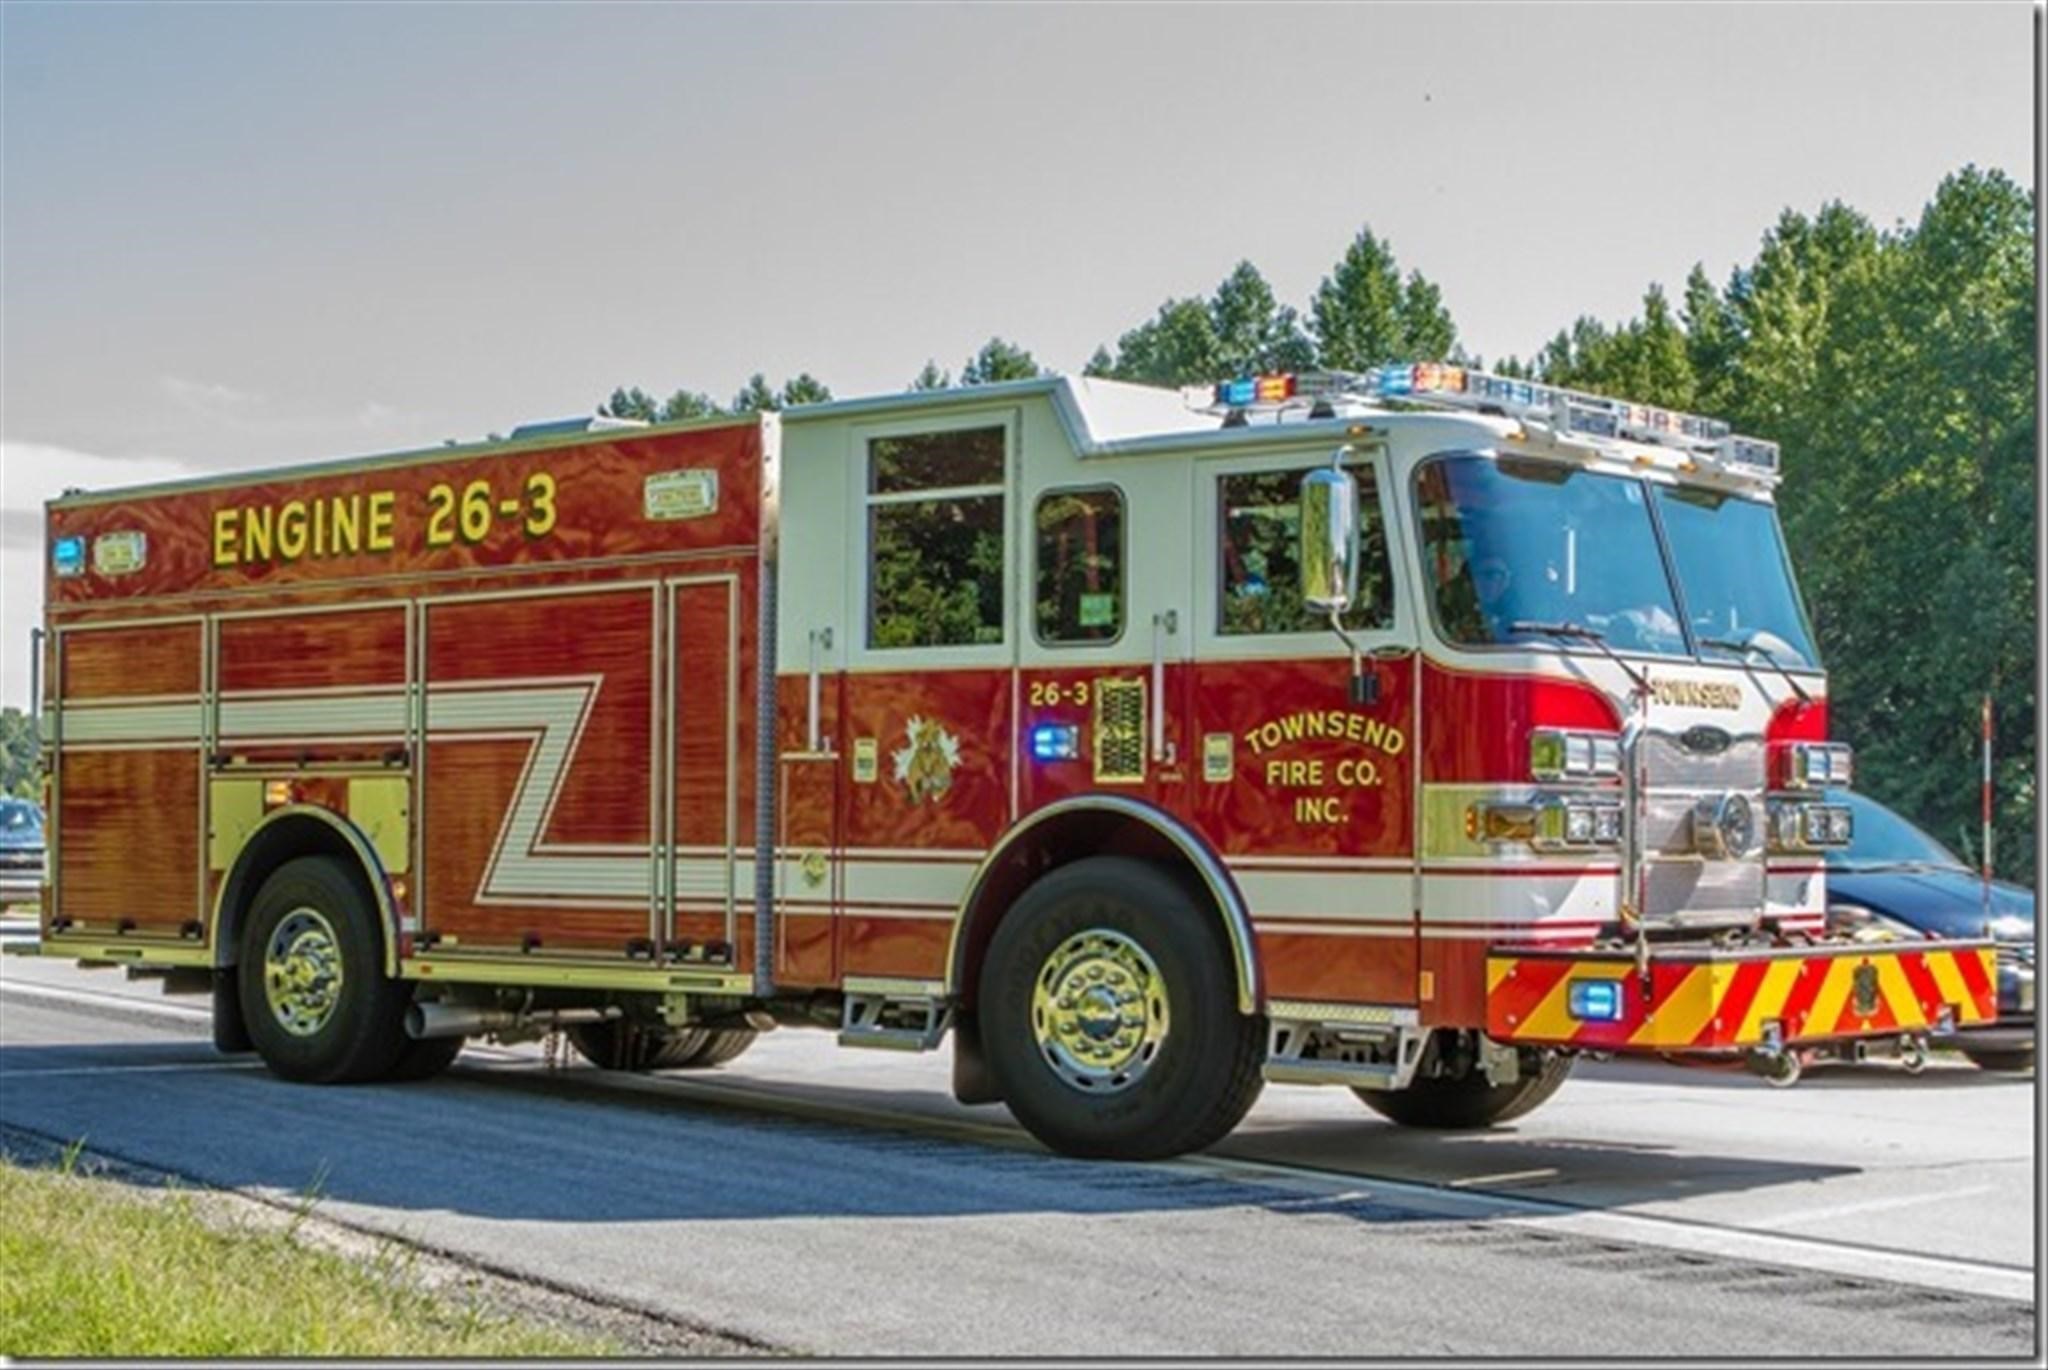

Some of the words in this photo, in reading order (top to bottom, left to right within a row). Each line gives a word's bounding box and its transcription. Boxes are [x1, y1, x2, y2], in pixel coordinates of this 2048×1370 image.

[213, 491, 395, 565] ENGINE
[427, 472, 557, 545] 26-3
[1029, 681, 1089, 706] 26-3
[1651, 679, 1741, 710] TOWNSEND
[1244, 710, 1404, 755] TOWNSEND
[1266, 760, 1324, 785] FIRE
[1336, 760, 1382, 785] CO.
[1294, 797, 1349, 823] INC.
